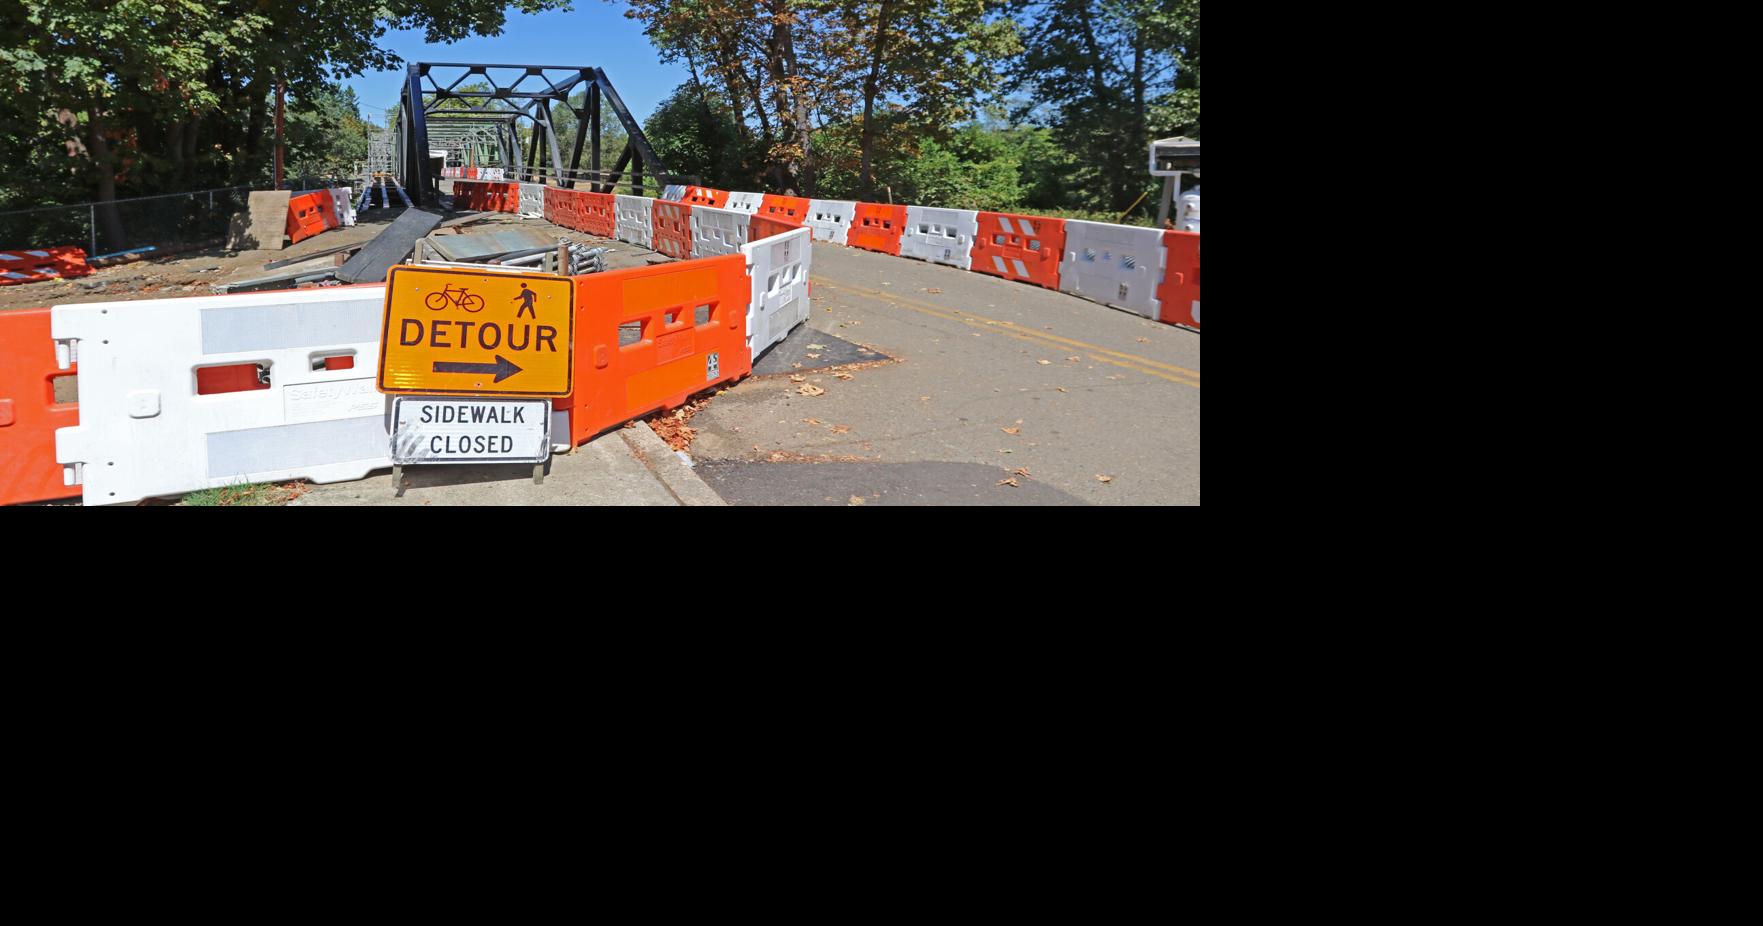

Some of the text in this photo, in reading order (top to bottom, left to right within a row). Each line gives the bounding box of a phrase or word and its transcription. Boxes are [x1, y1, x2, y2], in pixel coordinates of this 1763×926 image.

[400, 318, 558, 352] DETOUR
[420, 405, 525, 424] SIDEWALK
[430, 435, 513, 454] CLOSED
